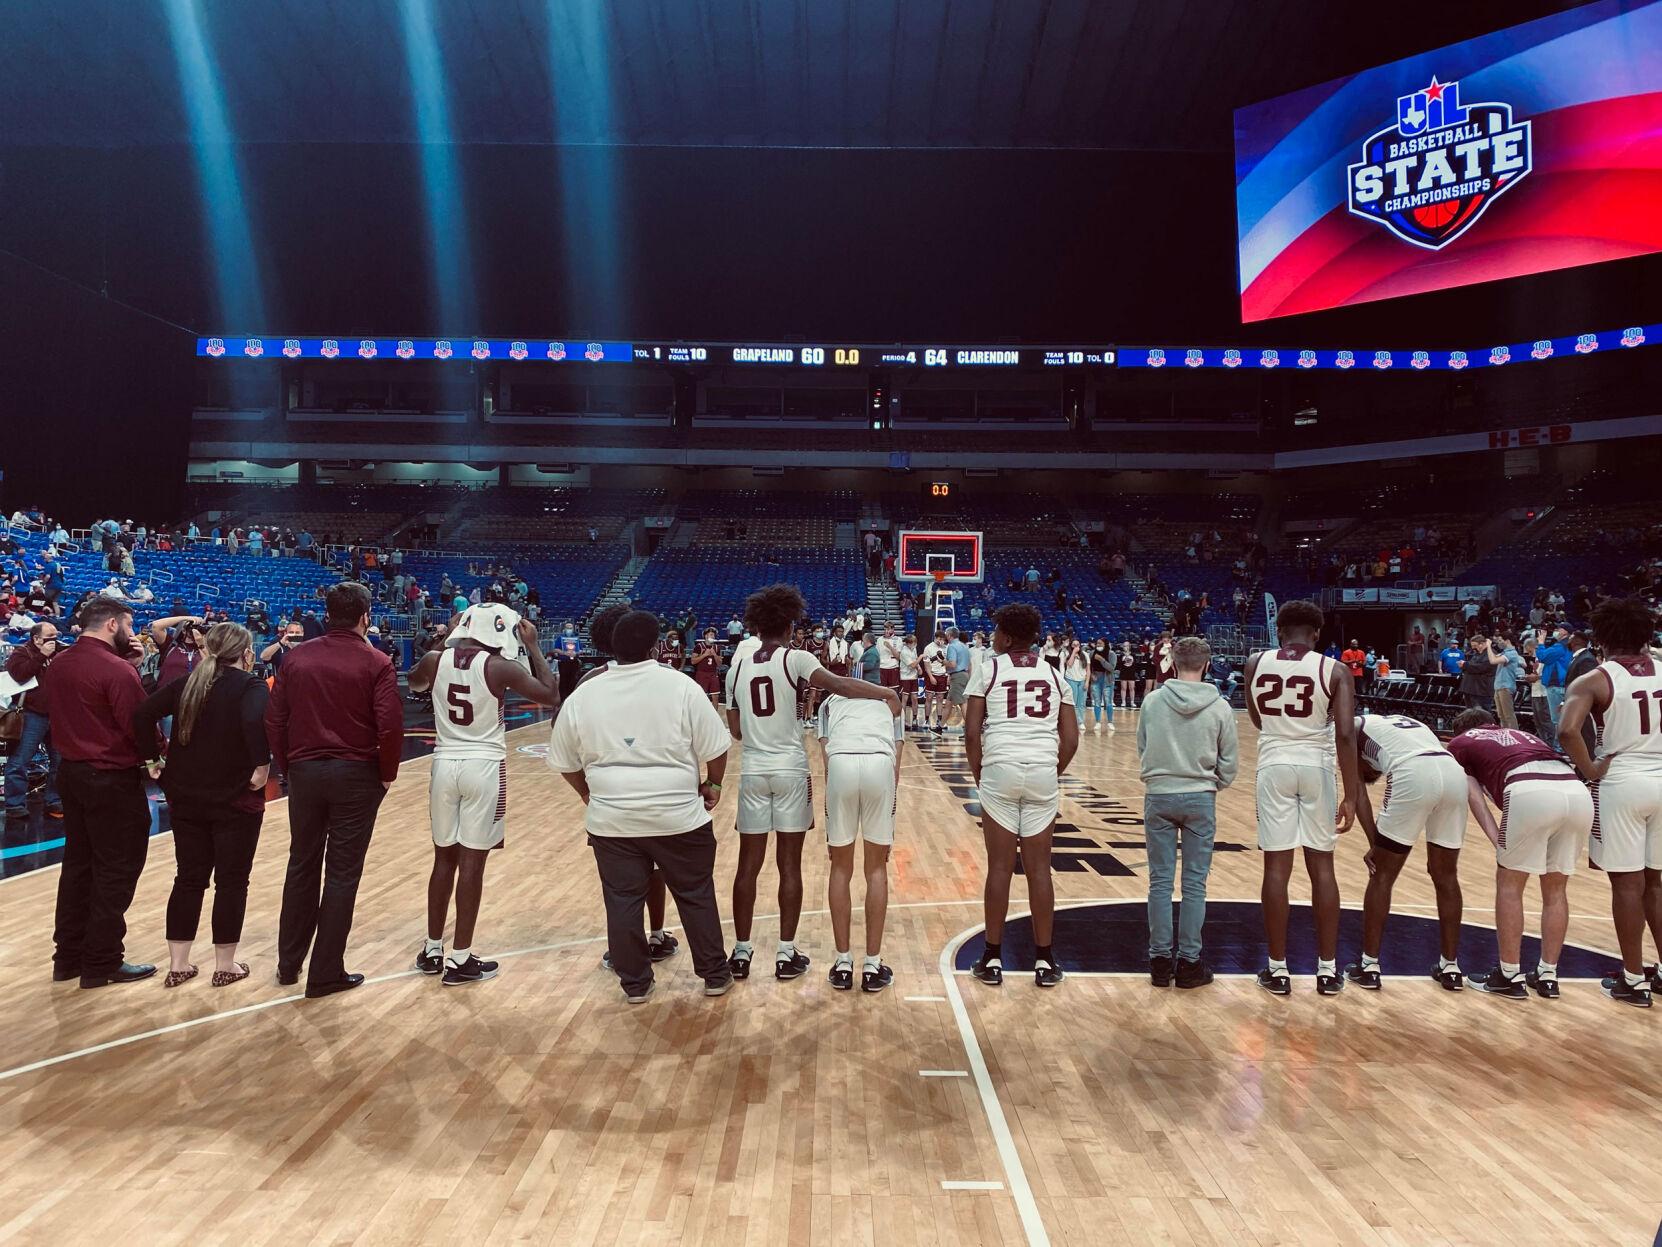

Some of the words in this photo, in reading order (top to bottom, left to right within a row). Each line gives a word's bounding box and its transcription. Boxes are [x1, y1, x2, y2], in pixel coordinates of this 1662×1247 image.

[1398, 82, 1470, 137] UIL
[1389, 123, 1483, 159] BASKETBALL
[1355, 129, 1524, 204] STATE
[1384, 178, 1492, 213] CHAMPIONSHIPS
[635, 349, 649, 358] TOL
[653, 347, 661, 359] 1
[690, 348, 707, 361] 10
[733, 348, 794, 362] GRAPELAND
[801, 347, 824, 365] 60
[835, 349, 859, 365] 0.0
[906, 351, 917, 363] 4
[925, 349, 948, 366] 64
[957, 351, 1019, 365] CLARENDON
[1067, 351, 1084, 364] 10
[1087, 354, 1101, 363] TOL
[1104, 351, 1115, 364] 0
[1488, 425, 1572, 449] H-E-B
[932, 484, 949, 496] 0.0
[447, 683, 474, 726] 5
[750, 676, 776, 717] 0
[1001, 679, 1051, 719] 13
[1256, 673, 1315, 719] 23
